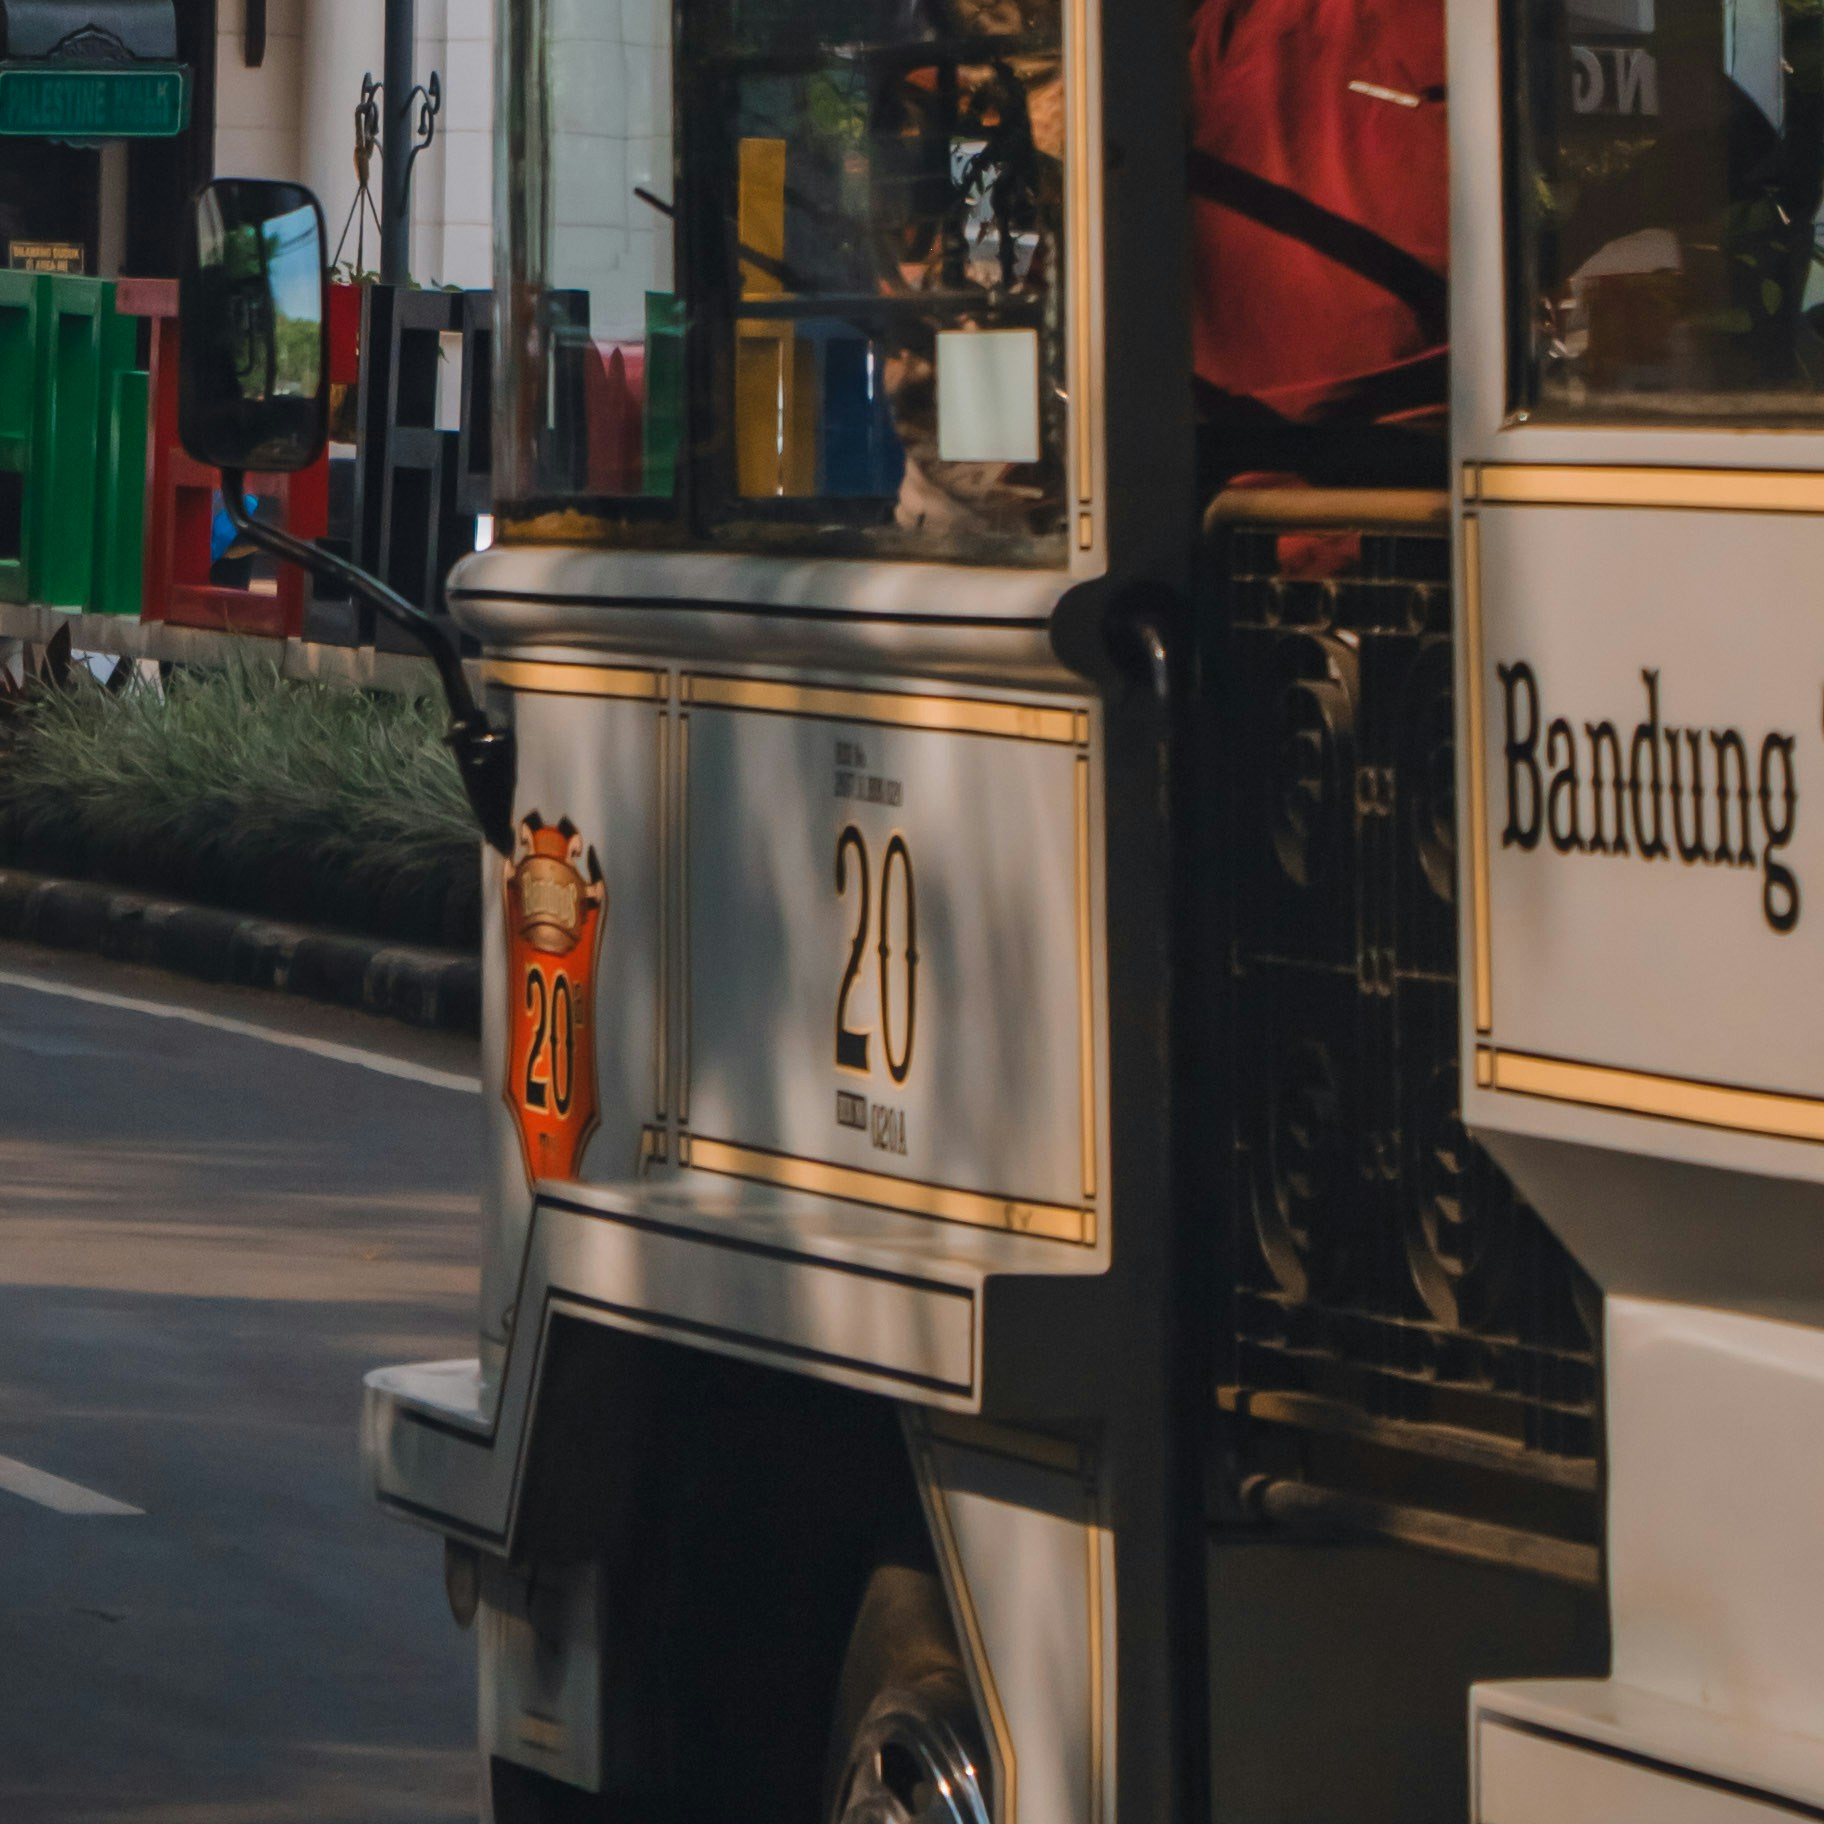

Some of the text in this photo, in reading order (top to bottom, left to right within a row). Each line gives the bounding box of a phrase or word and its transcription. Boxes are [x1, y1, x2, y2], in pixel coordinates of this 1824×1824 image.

[1498, 658, 1802, 936] Bandung
[525, 963, 576, 1121] 20
[833, 822, 920, 1084] 20
